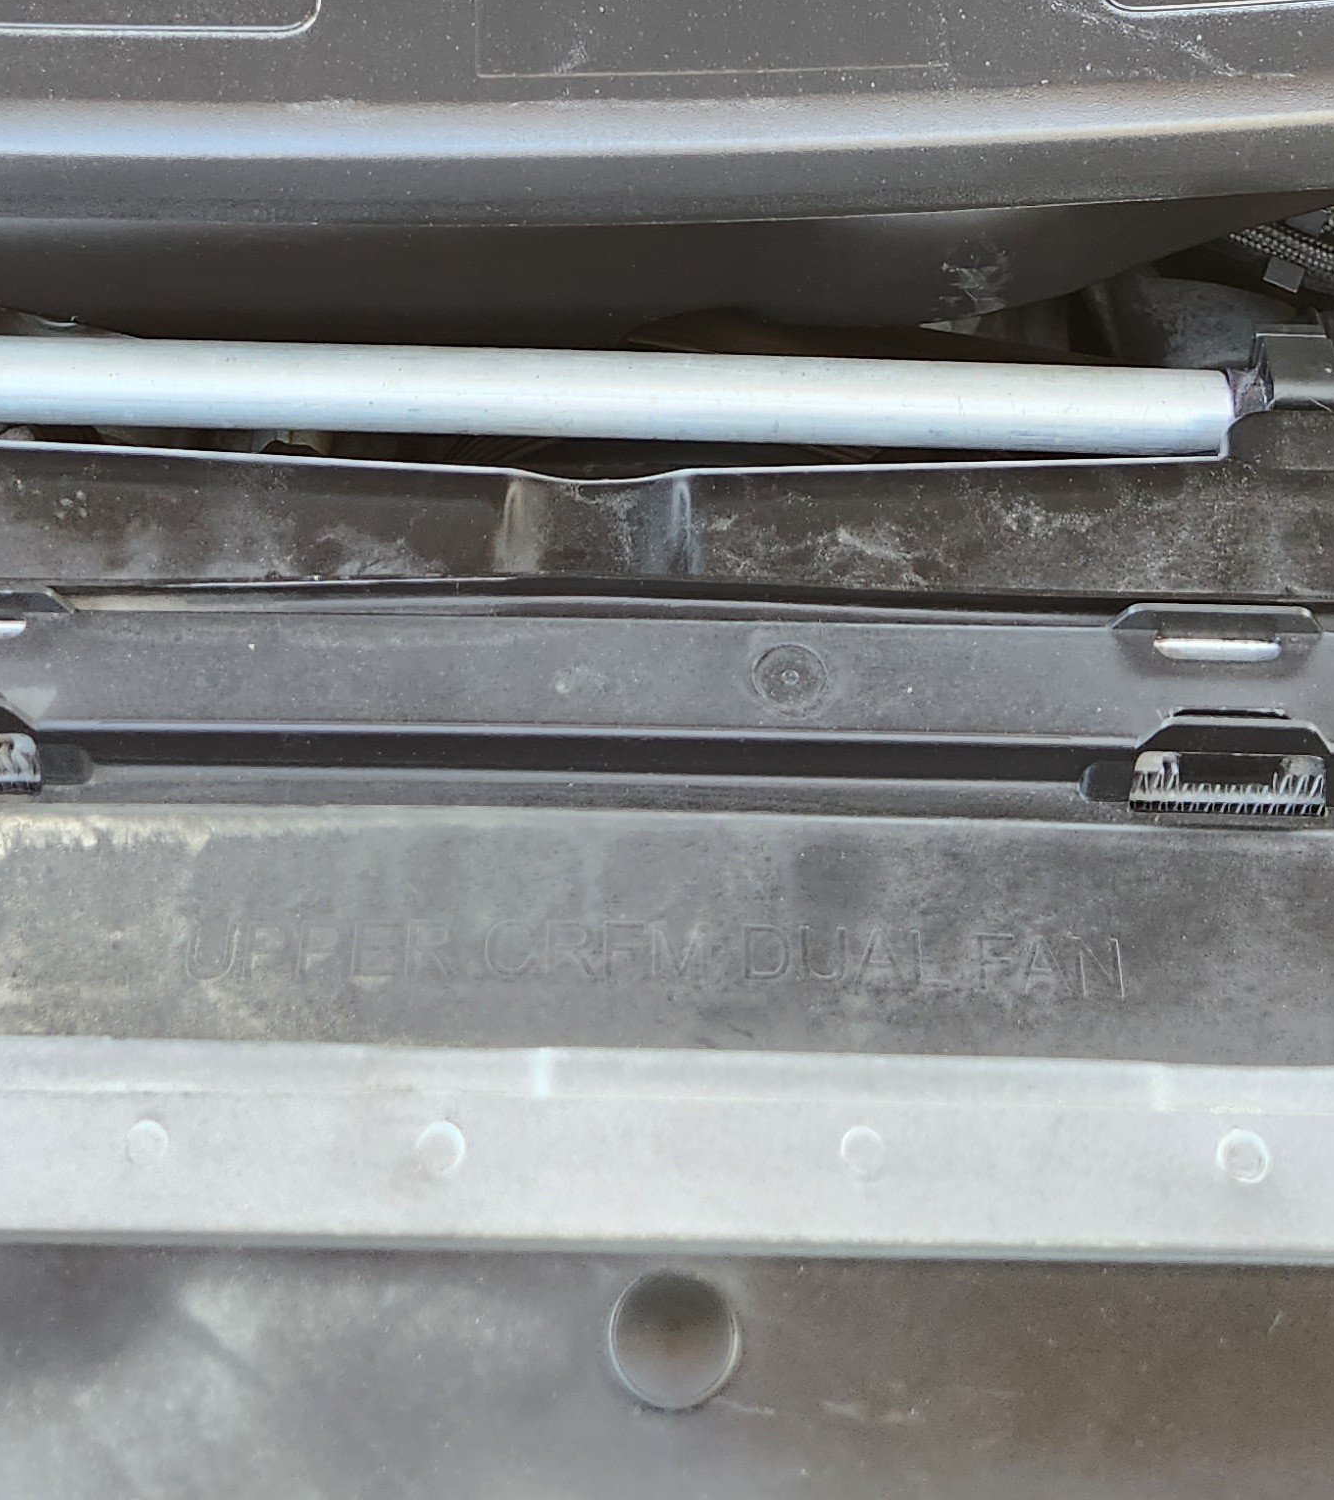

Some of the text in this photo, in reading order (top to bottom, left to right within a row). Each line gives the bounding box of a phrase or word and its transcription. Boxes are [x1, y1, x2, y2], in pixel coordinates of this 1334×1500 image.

[183, 917, 457, 983] UPPER
[741, 921, 951, 989] DUAL
[970, 931, 1125, 1000] FAN
